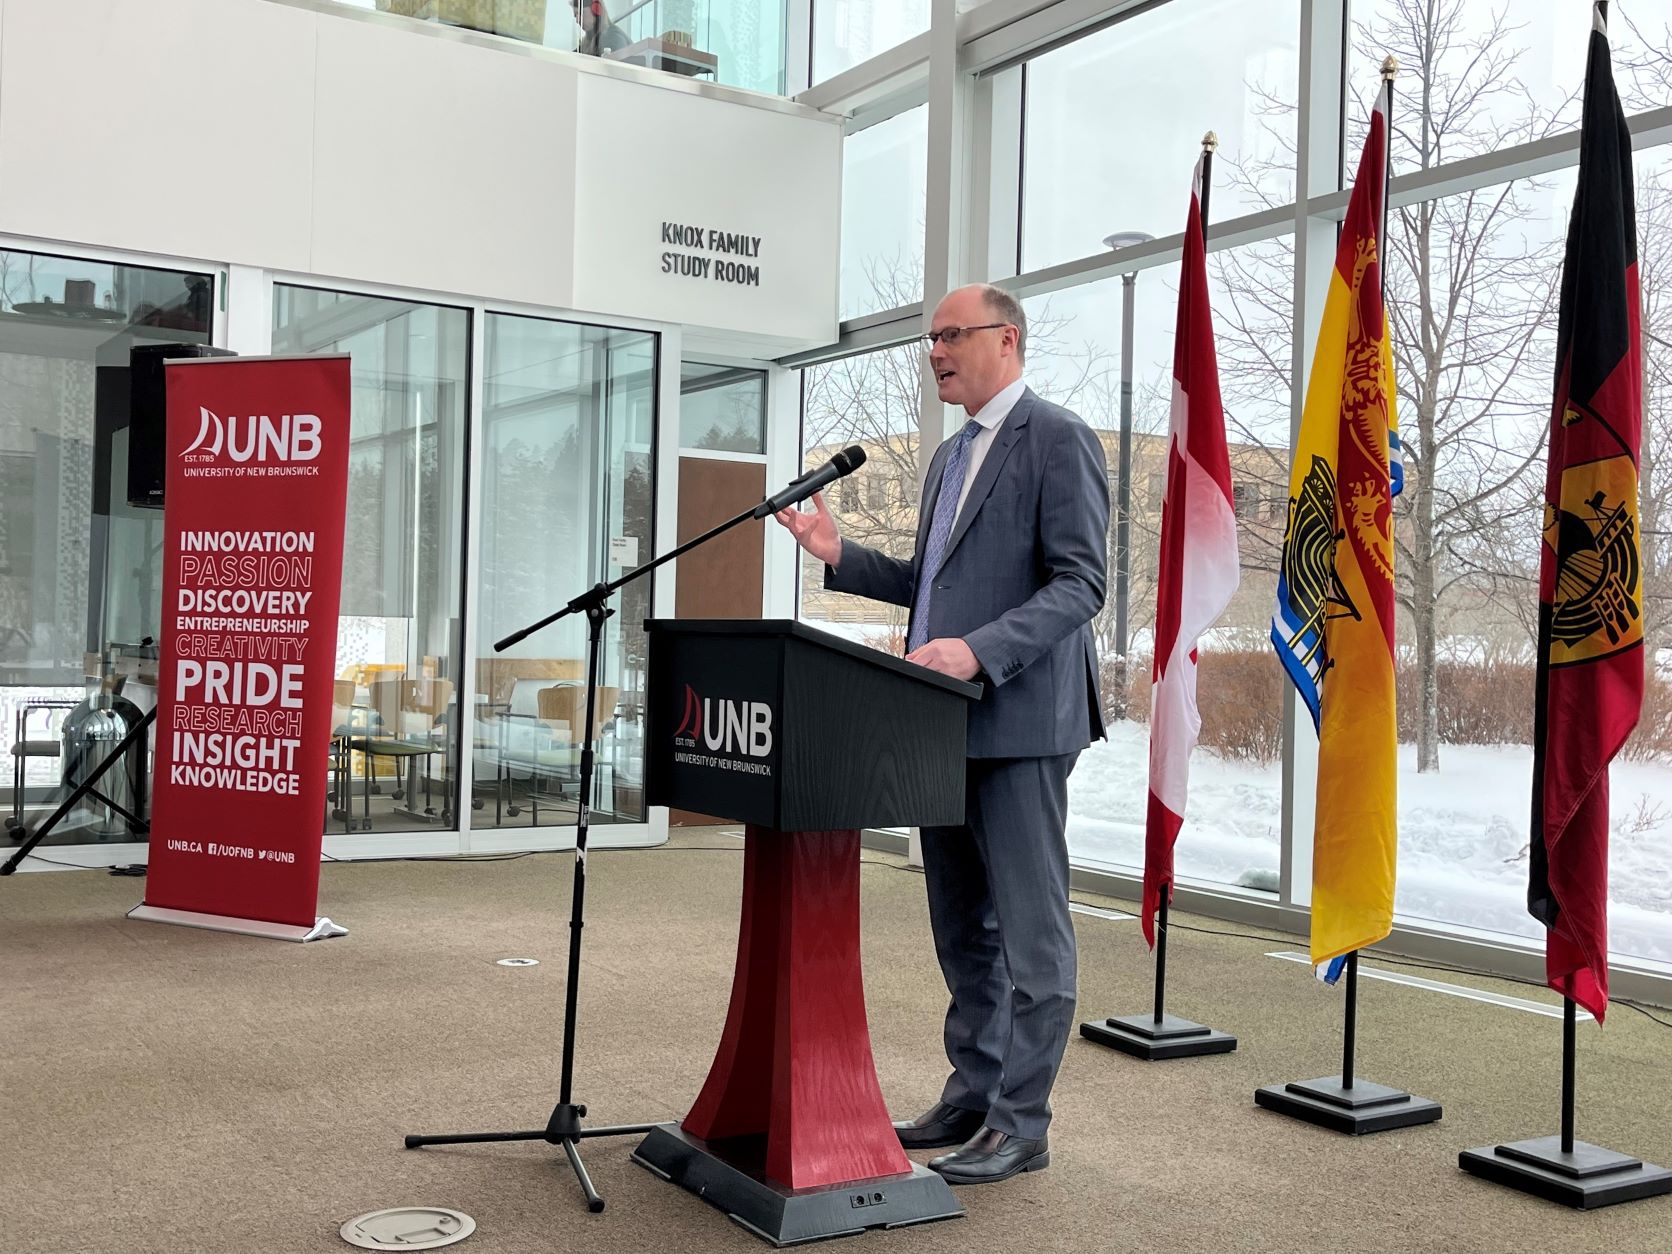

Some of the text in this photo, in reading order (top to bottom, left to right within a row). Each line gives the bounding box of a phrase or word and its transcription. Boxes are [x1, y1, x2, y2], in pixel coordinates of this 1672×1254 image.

[662, 222, 761, 258] KNOX FAMILY
[661, 252, 760, 287] STUDY ROOM
[227, 414, 322, 463] UNB
[184, 466, 319, 477] UNIVERSITY OF NEW BRUNSWICK
[180, 531, 315, 553] INNOVATION
[179, 555, 312, 588] PASSION
[177, 589, 313, 615] DISCOVERY
[176, 616, 310, 634] ENTREPRENEURSHIP
[175, 633, 309, 661] CREATIVITY
[175, 659, 305, 709] PRIDE
[173, 704, 303, 737] RESEARCH
[703, 697, 773, 758] UNB
[172, 731, 301, 771] INSIGHT
[675, 752, 771, 776] UNIVERSITY OF NEW BRUNSWICK
[170, 764, 300, 796] KNOWLEDGE
[167, 839, 203, 853] UNB.CA
[266, 850, 295, 864] @UNB
